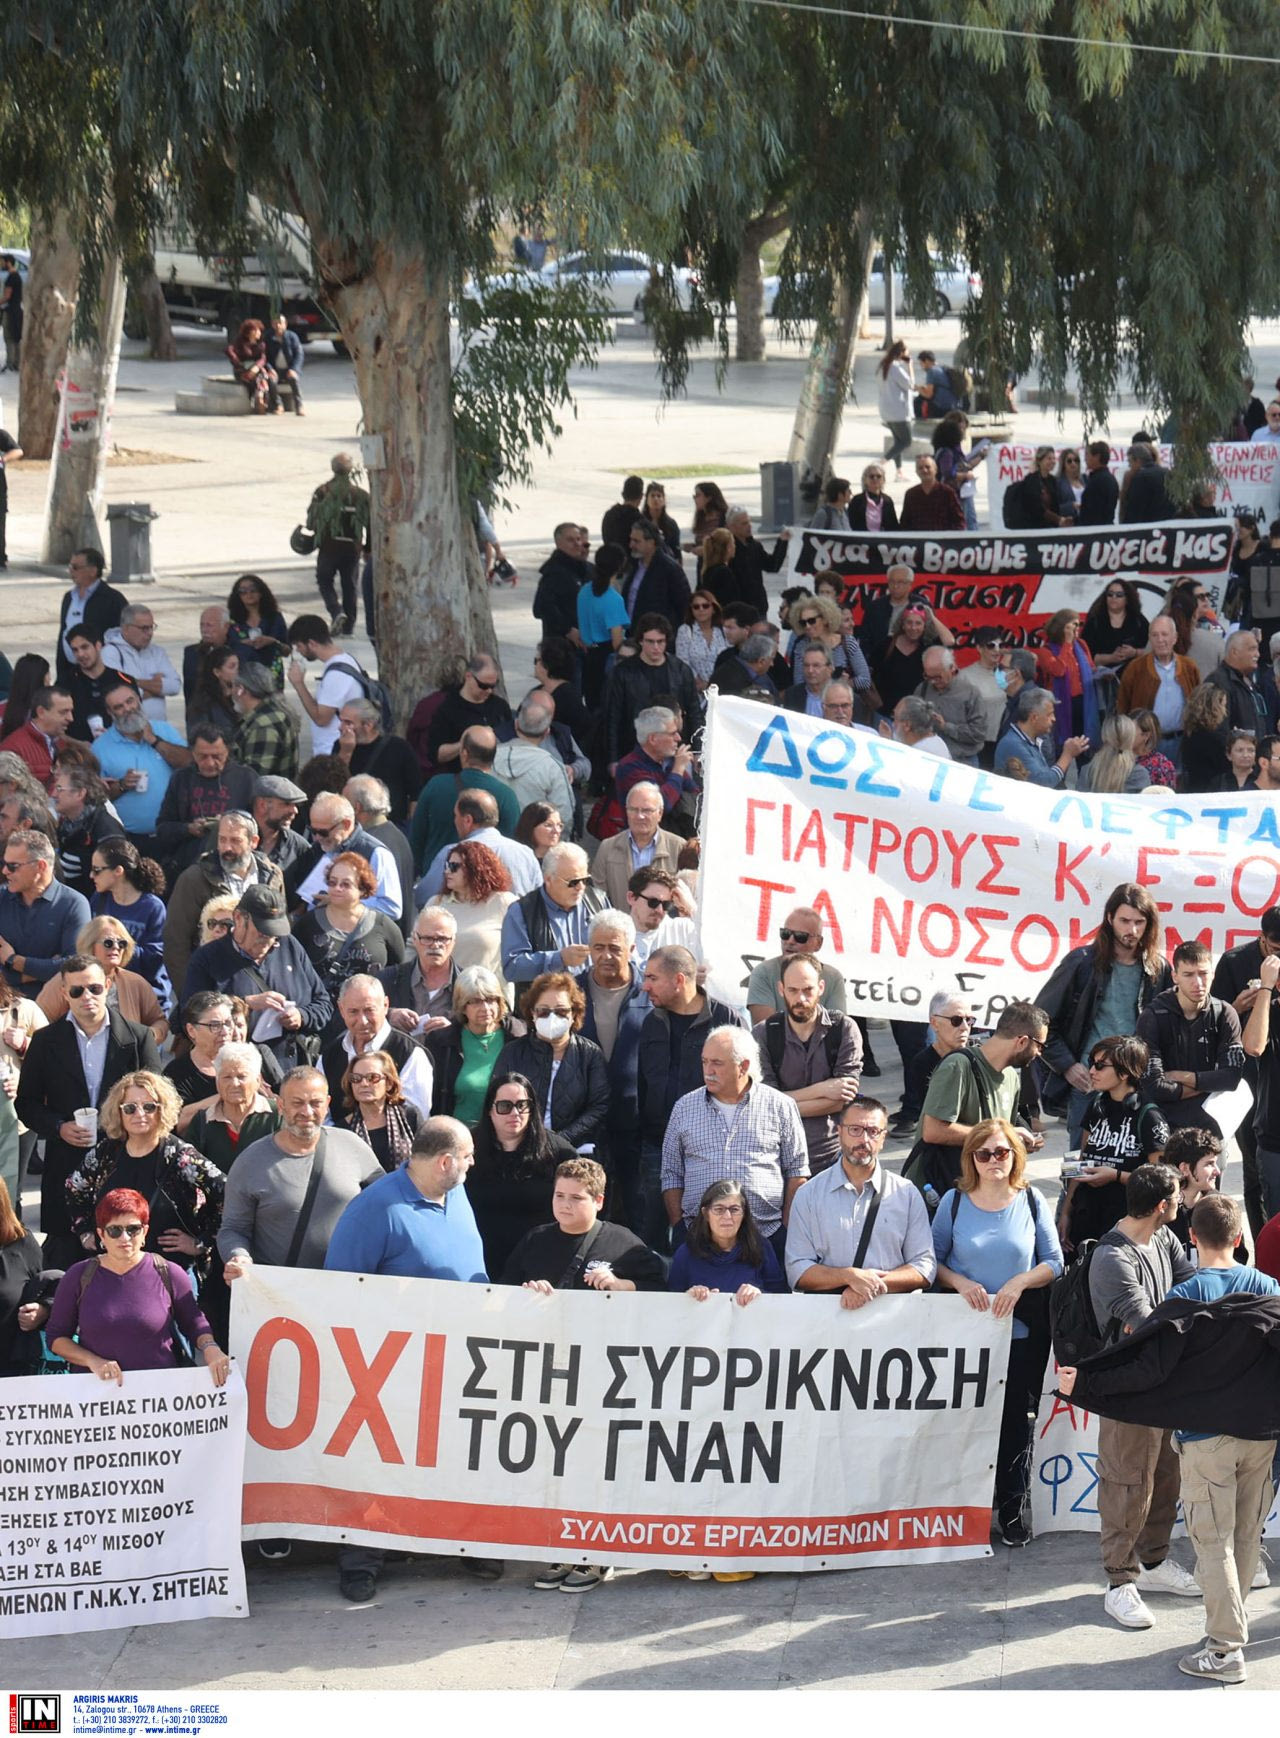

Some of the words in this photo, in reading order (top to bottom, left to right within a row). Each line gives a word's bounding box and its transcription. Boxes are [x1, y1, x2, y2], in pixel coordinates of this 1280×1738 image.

[746, 715, 1004, 812] ΔΩΣΤΕ
[745, 798, 1021, 896] ΓΙΑΤΡΟΥΣ
[462, 1336, 582, 1405] ΣΤΗ
[601, 1345, 990, 1412] ΣΥΡΡΙΚΝΩΣΗ
[0, 1402, 73, 1420] ΣΥΣΤΗΜΑ
[79, 1399, 137, 1419] ΥΓΕΙΑΣ
[142, 1396, 168, 1415] ΓΙΑ
[173, 1392, 228, 1412] ΟΛΟΥΣ
[246, 1317, 447, 1469] ΟΧΙ
[5, 1425, 117, 1446] ΣΥΓΧΩΝΕΥΣΕΙΣ
[120, 1415, 229, 1441] ΝΟΣΟΚΟΜΕΙΩΝ
[459, 1408, 584, 1478] ΤΟΥ
[605, 1418, 784, 1485] ΓΝΑΝ
[0, 1456, 68, 1474] ΟΝΙΜΟΥ
[73, 1449, 182, 1472] ΠΡΟΣΩΠΙΚΟΥ
[34, 1478, 165, 1502] ΣΥΜΒΑΣΙΟΥΧΩΝ
[63, 1508, 117, 1528] ΣΤΟΥΣ
[121, 1500, 195, 1524] ΜΙΣΘΟΥΣ
[46, 1539, 58, 1555] &
[102, 1530, 166, 1552] ΜΙΣΘΟΥ
[560, 1516, 697, 1548] ΣΥΛΛΟΓΟΣ
[704, 1519, 893, 1549] ΕΡΓΑΖΟΜΕΝΩΝ
[897, 1513, 965, 1542] ΓΝΑΝ
[34, 1562, 66, 1579] ΣΤΑ
[70, 1560, 103, 1578] ΒΑΕ
[152, 1575, 230, 1603] ΣΗΤΕΙΑΣ
